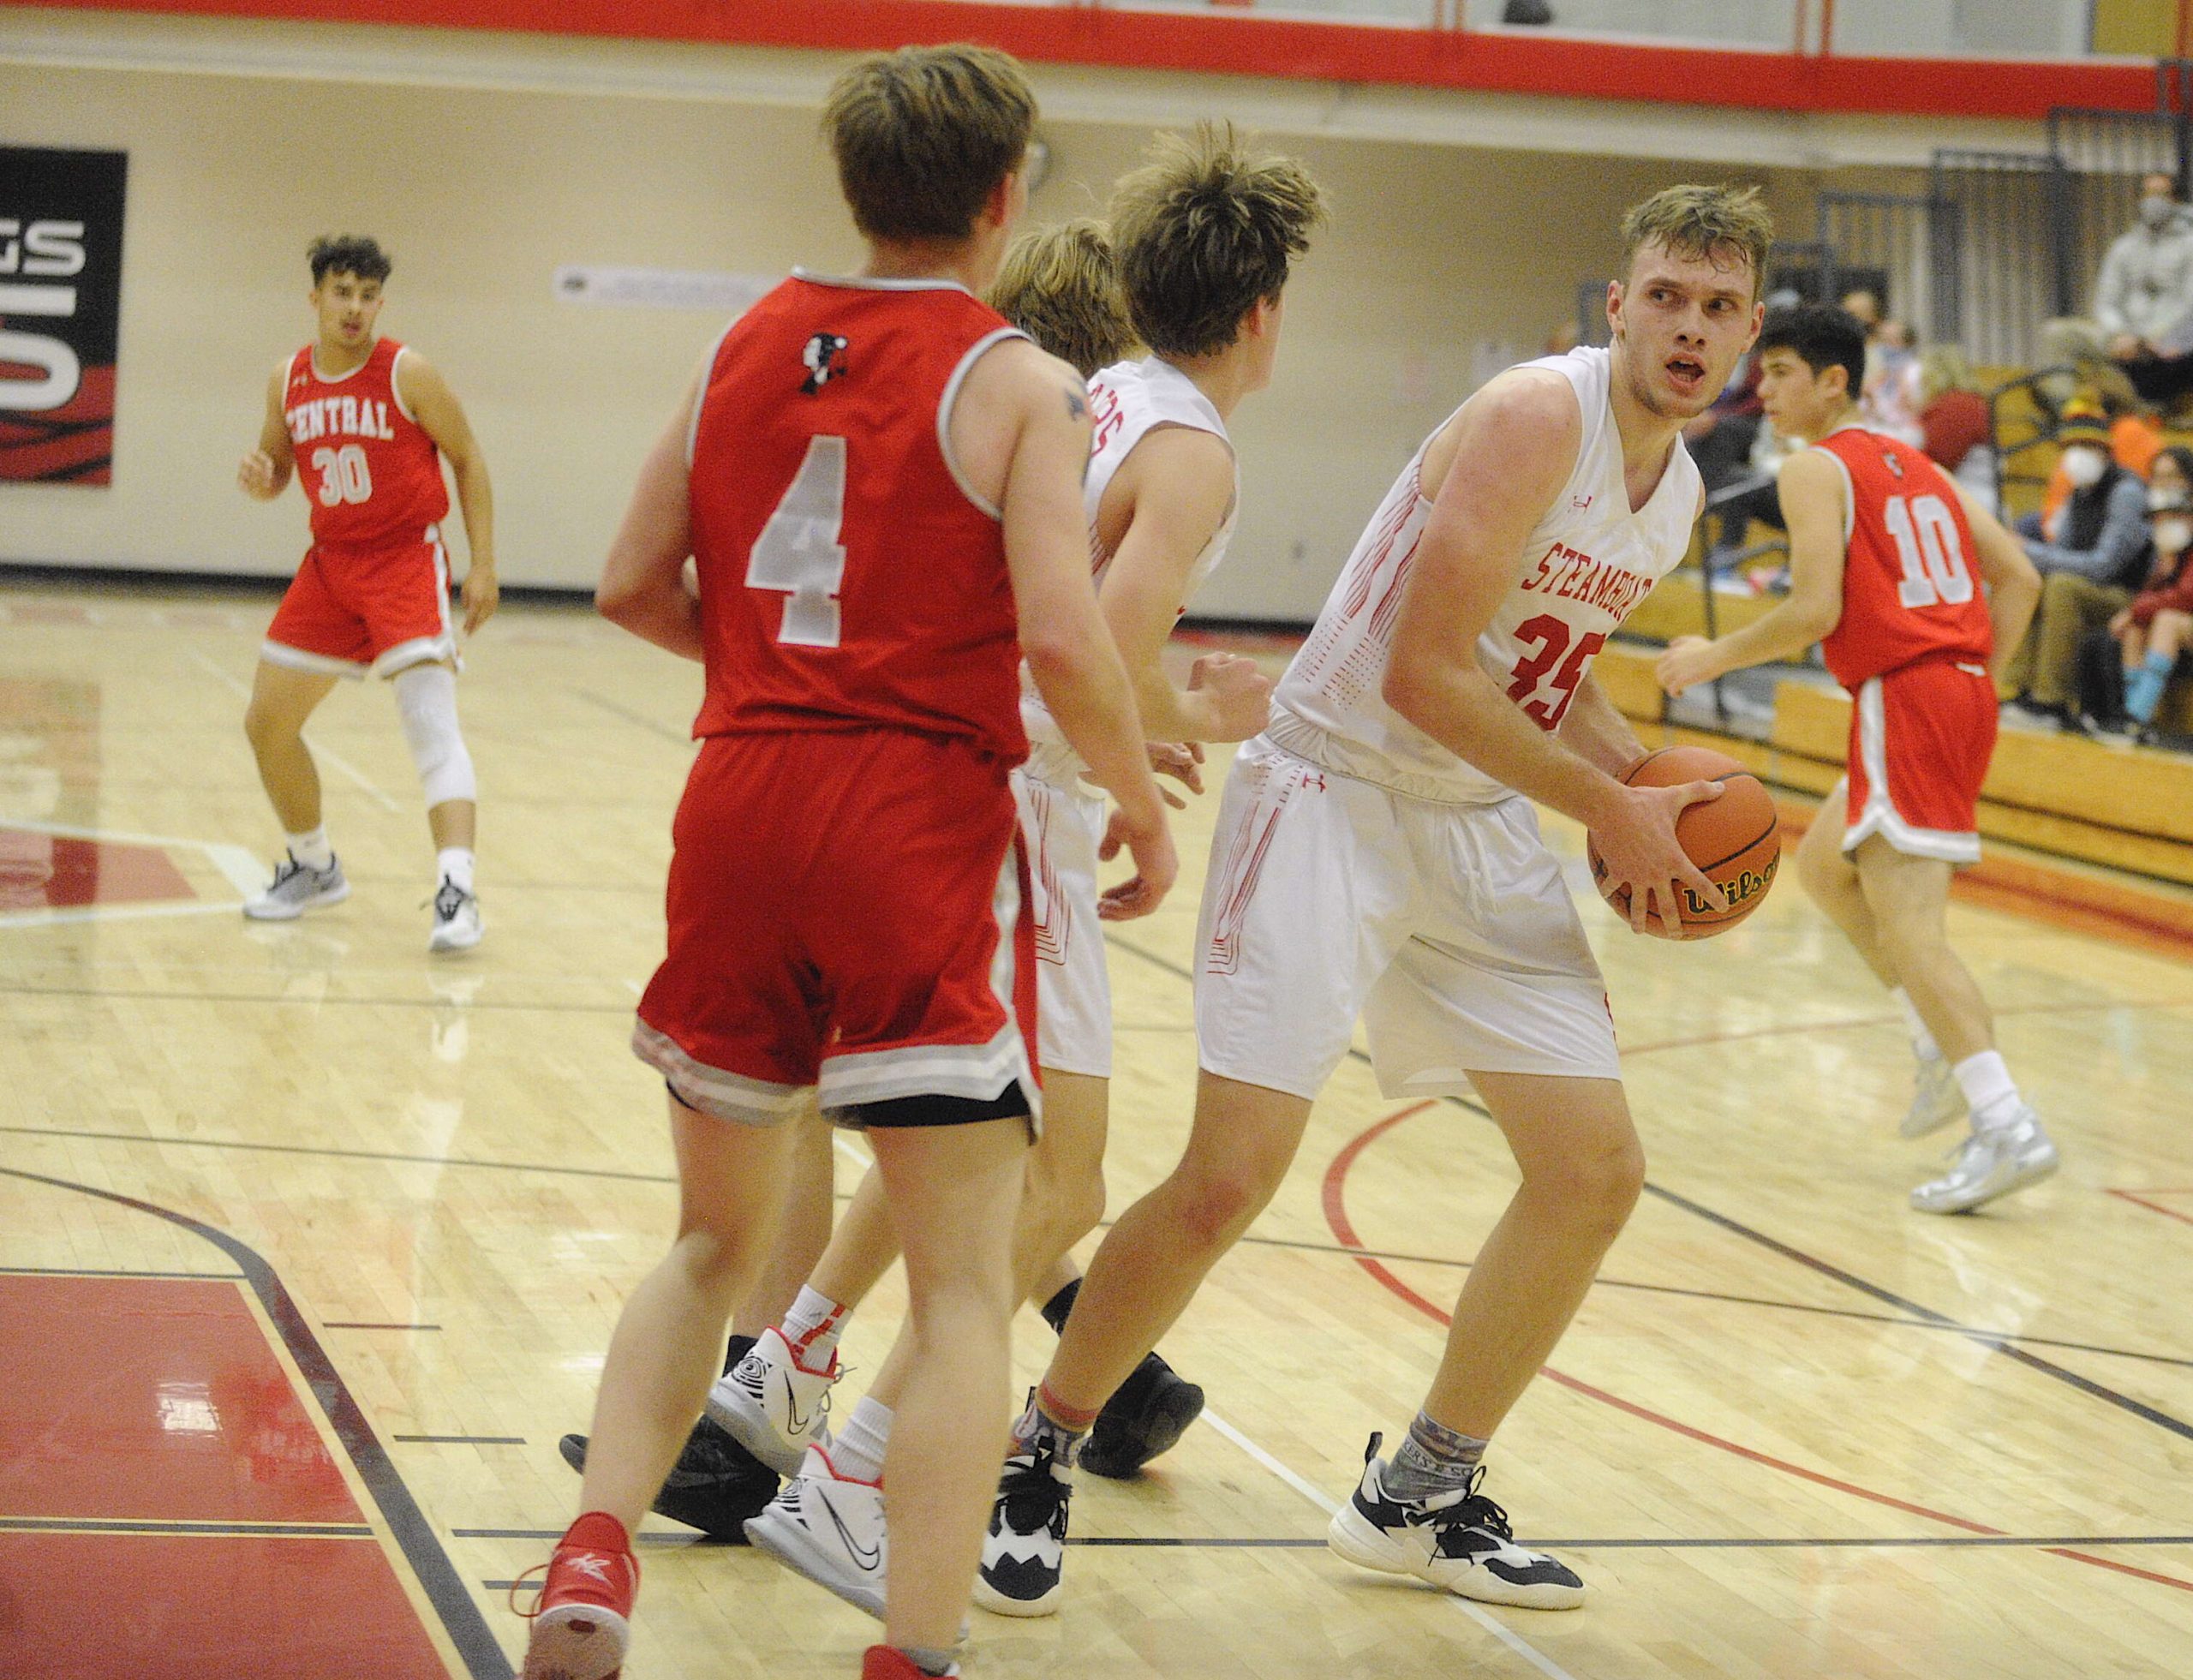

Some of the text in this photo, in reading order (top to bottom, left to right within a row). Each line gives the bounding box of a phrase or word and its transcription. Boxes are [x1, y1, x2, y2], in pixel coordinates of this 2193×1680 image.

[285, 395, 394, 445] CENTRAL
[311, 443, 373, 507] 30
[744, 434, 847, 648] 4
[1885, 493, 1975, 609] 10
[1505, 613, 1607, 732] 35
